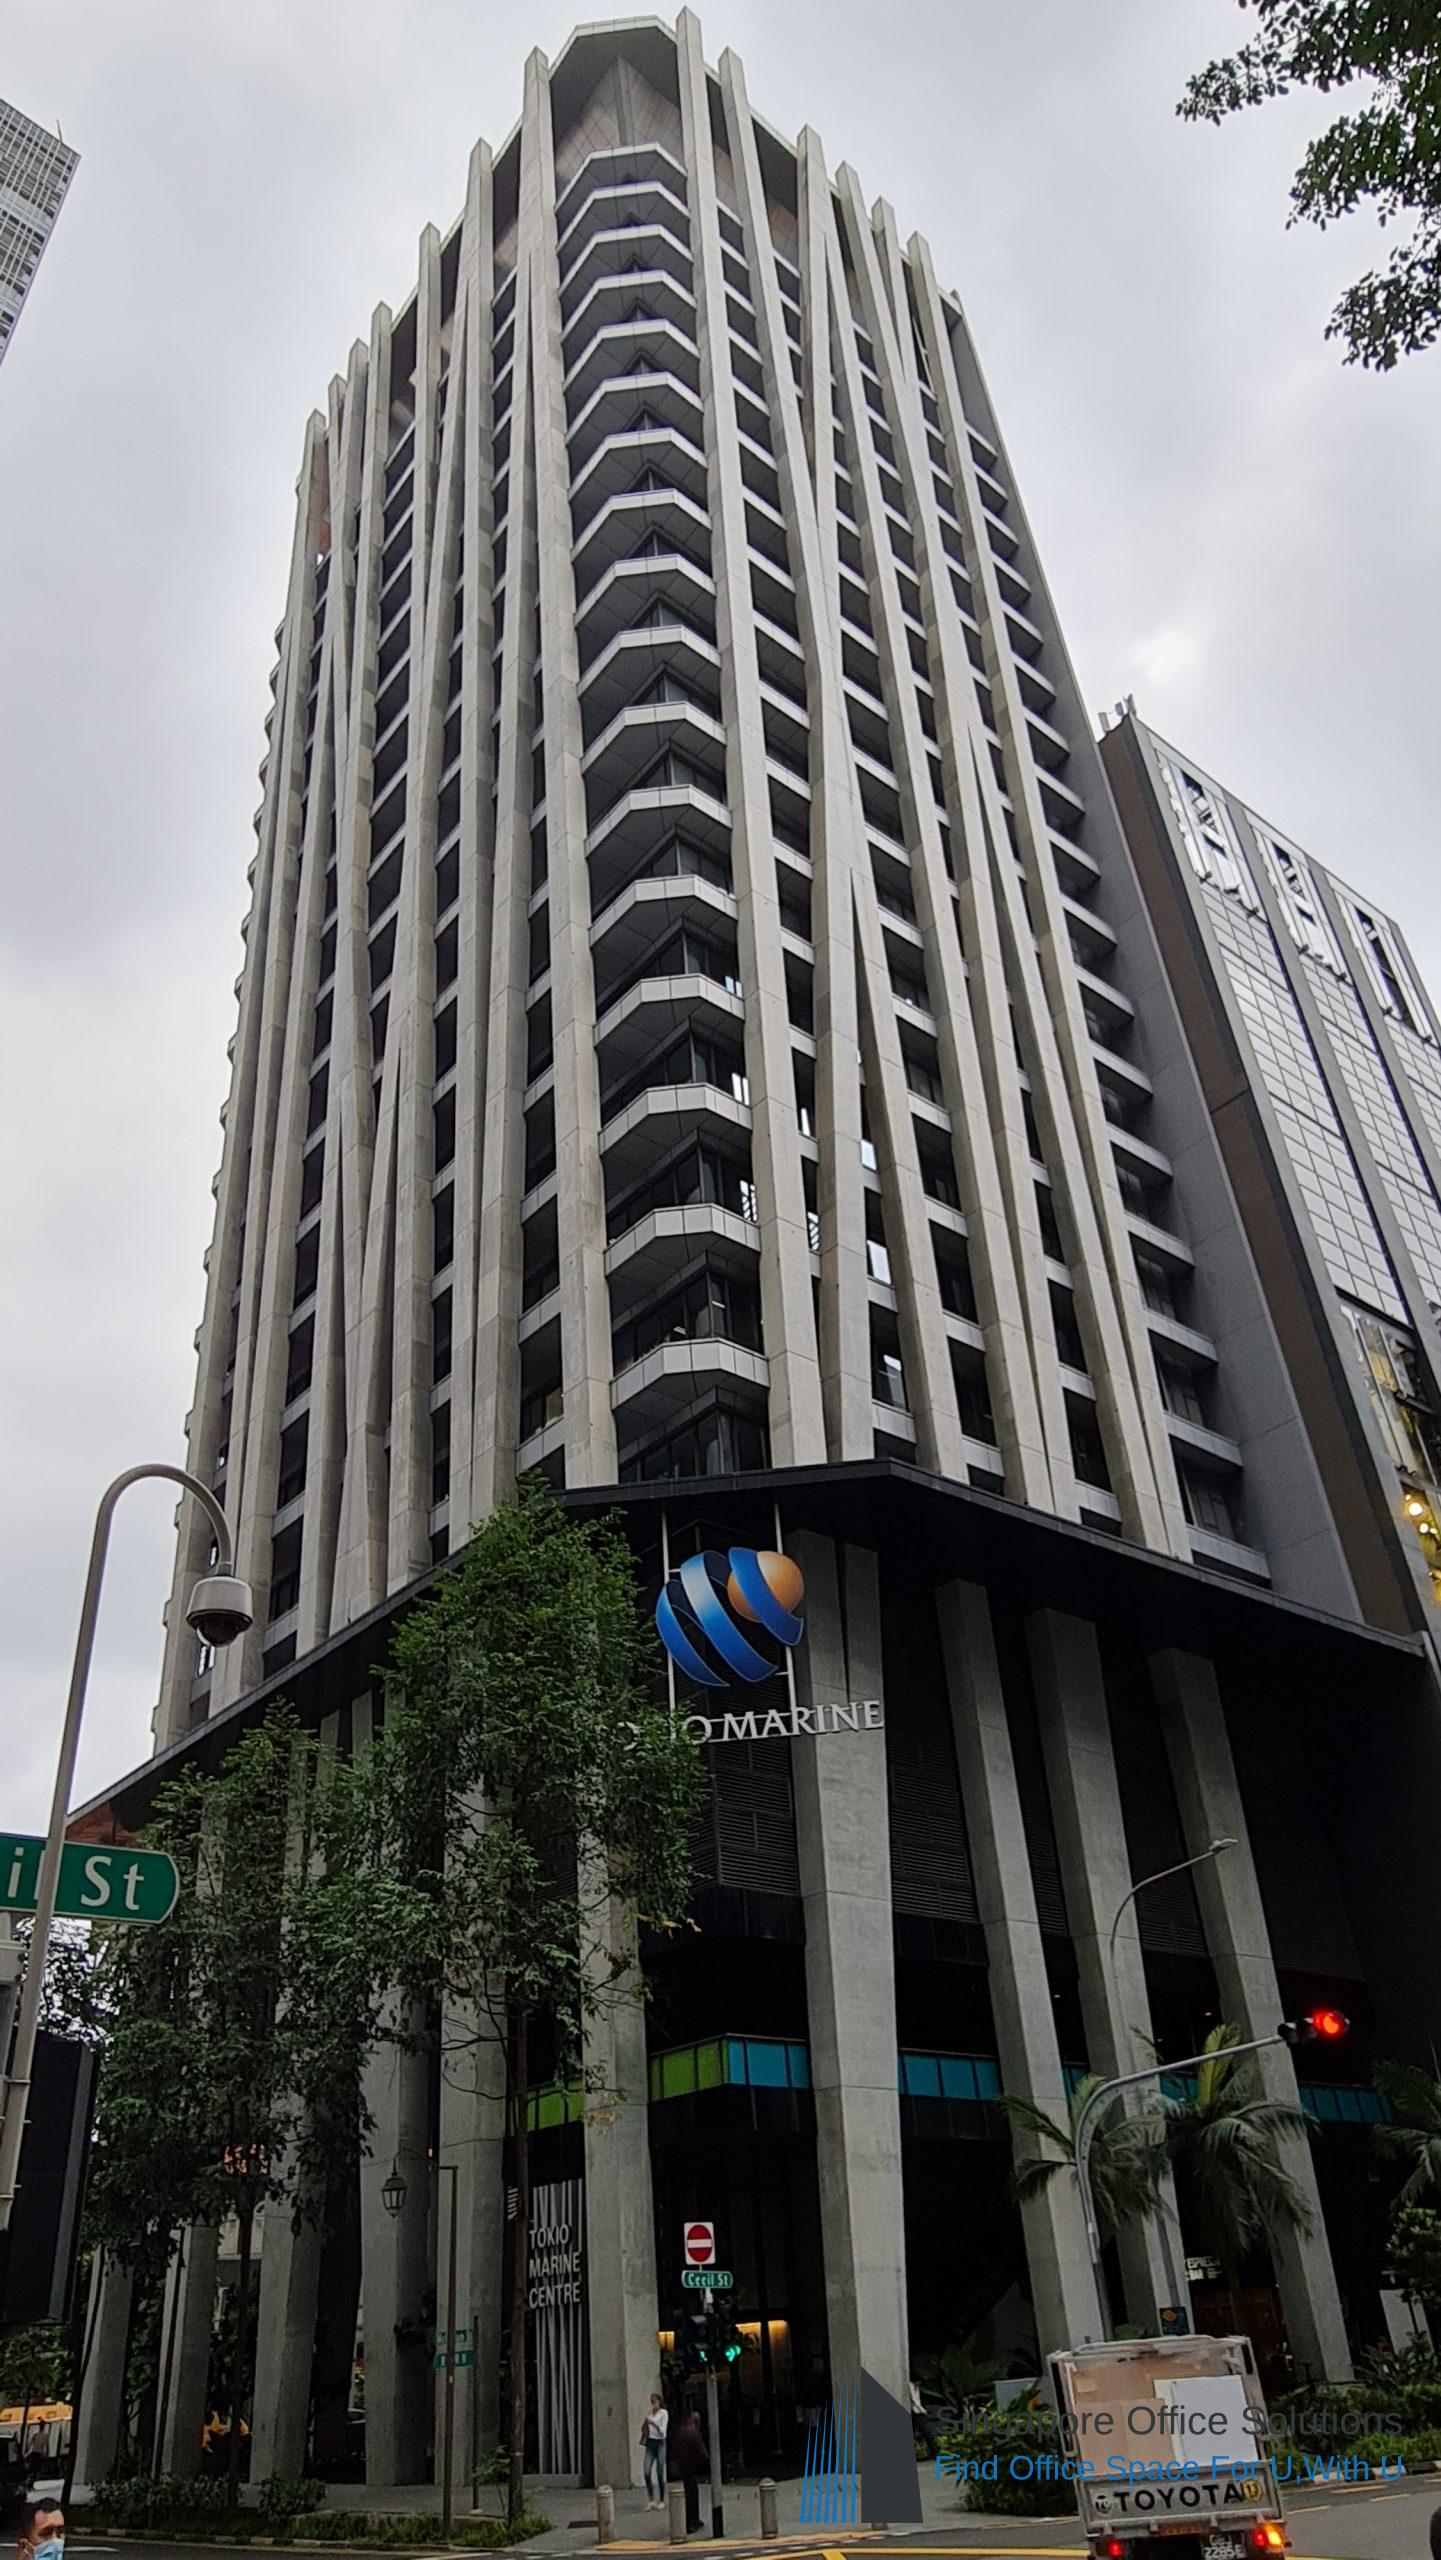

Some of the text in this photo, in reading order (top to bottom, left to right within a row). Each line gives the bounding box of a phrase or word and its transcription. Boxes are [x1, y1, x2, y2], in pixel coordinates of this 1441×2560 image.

[722, 1700, 884, 1741] MARINE
[80, 1855, 145, 1911] St
[528, 2223, 569, 2250] TOKIO
[529, 2251, 581, 2279] MARINE
[688, 2272, 729, 2287] Cecil St
[529, 2281, 581, 2309] CENTRE
[1114, 2482, 1244, 2513] TOYOTA
